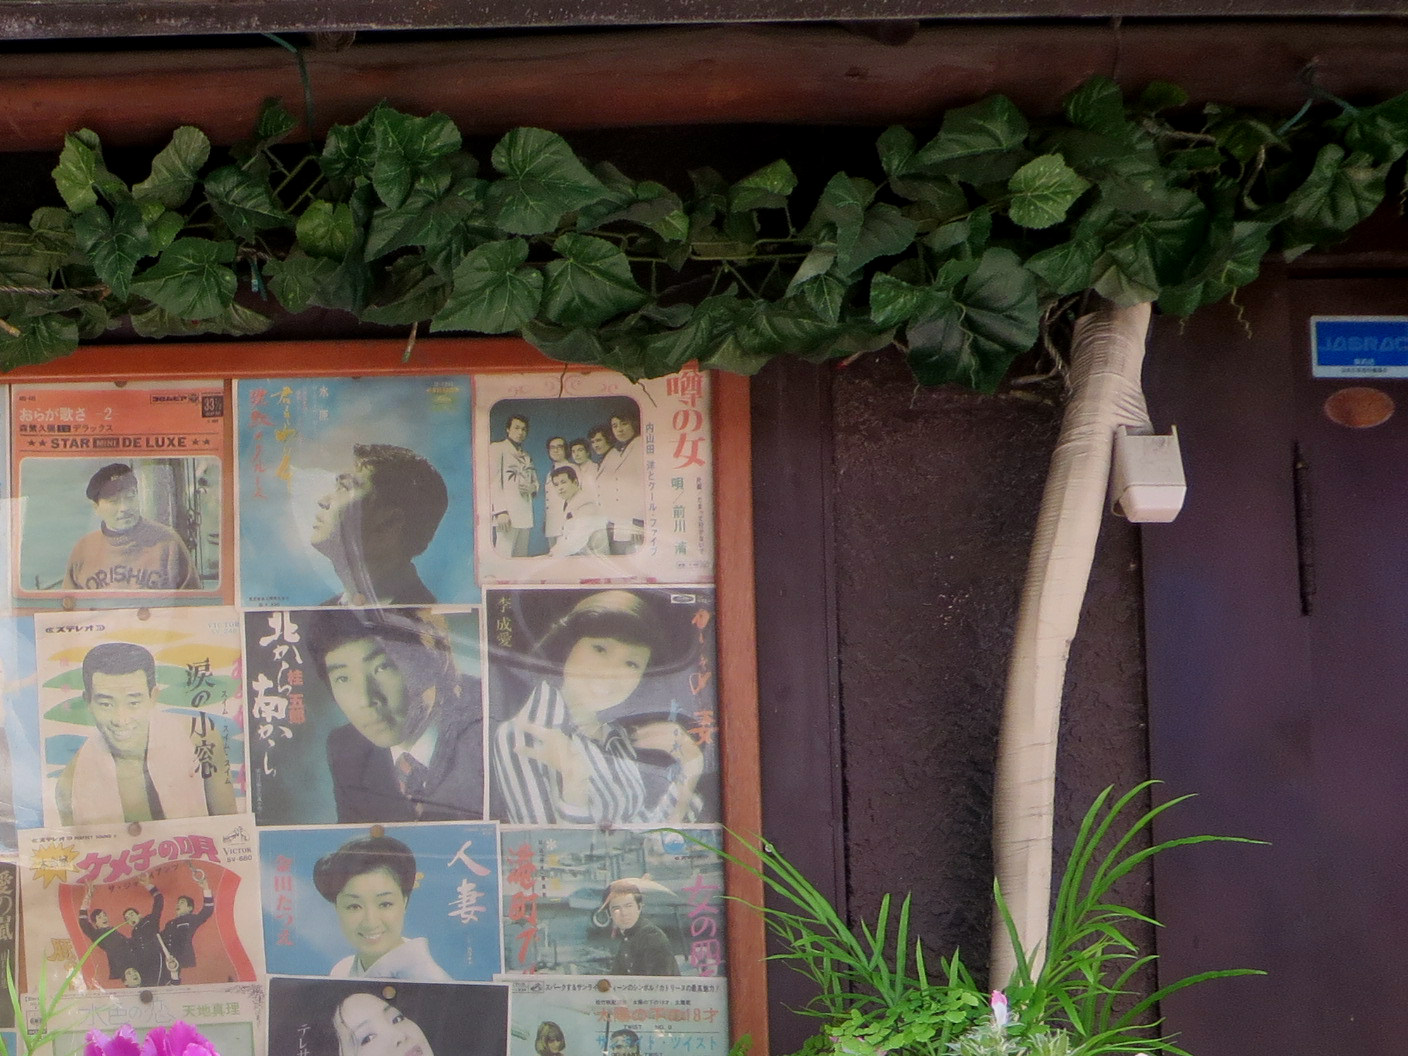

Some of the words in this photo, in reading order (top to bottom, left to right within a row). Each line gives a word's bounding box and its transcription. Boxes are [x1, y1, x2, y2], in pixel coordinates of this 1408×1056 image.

[19, 407, 86, 422] おらが歌さ
[50, 437, 90, 449] STAR
[93, 437, 119, 449] MINI
[122, 437, 141, 448] DE
[145, 436, 187, 448] LUXE
[184, 657, 219, 780] 涙の小窓
[75, 834, 221, 884] ケメ子の唄
[446, 839, 491, 925] 人妻
[183, 1002, 240, 1018] 天地真理
